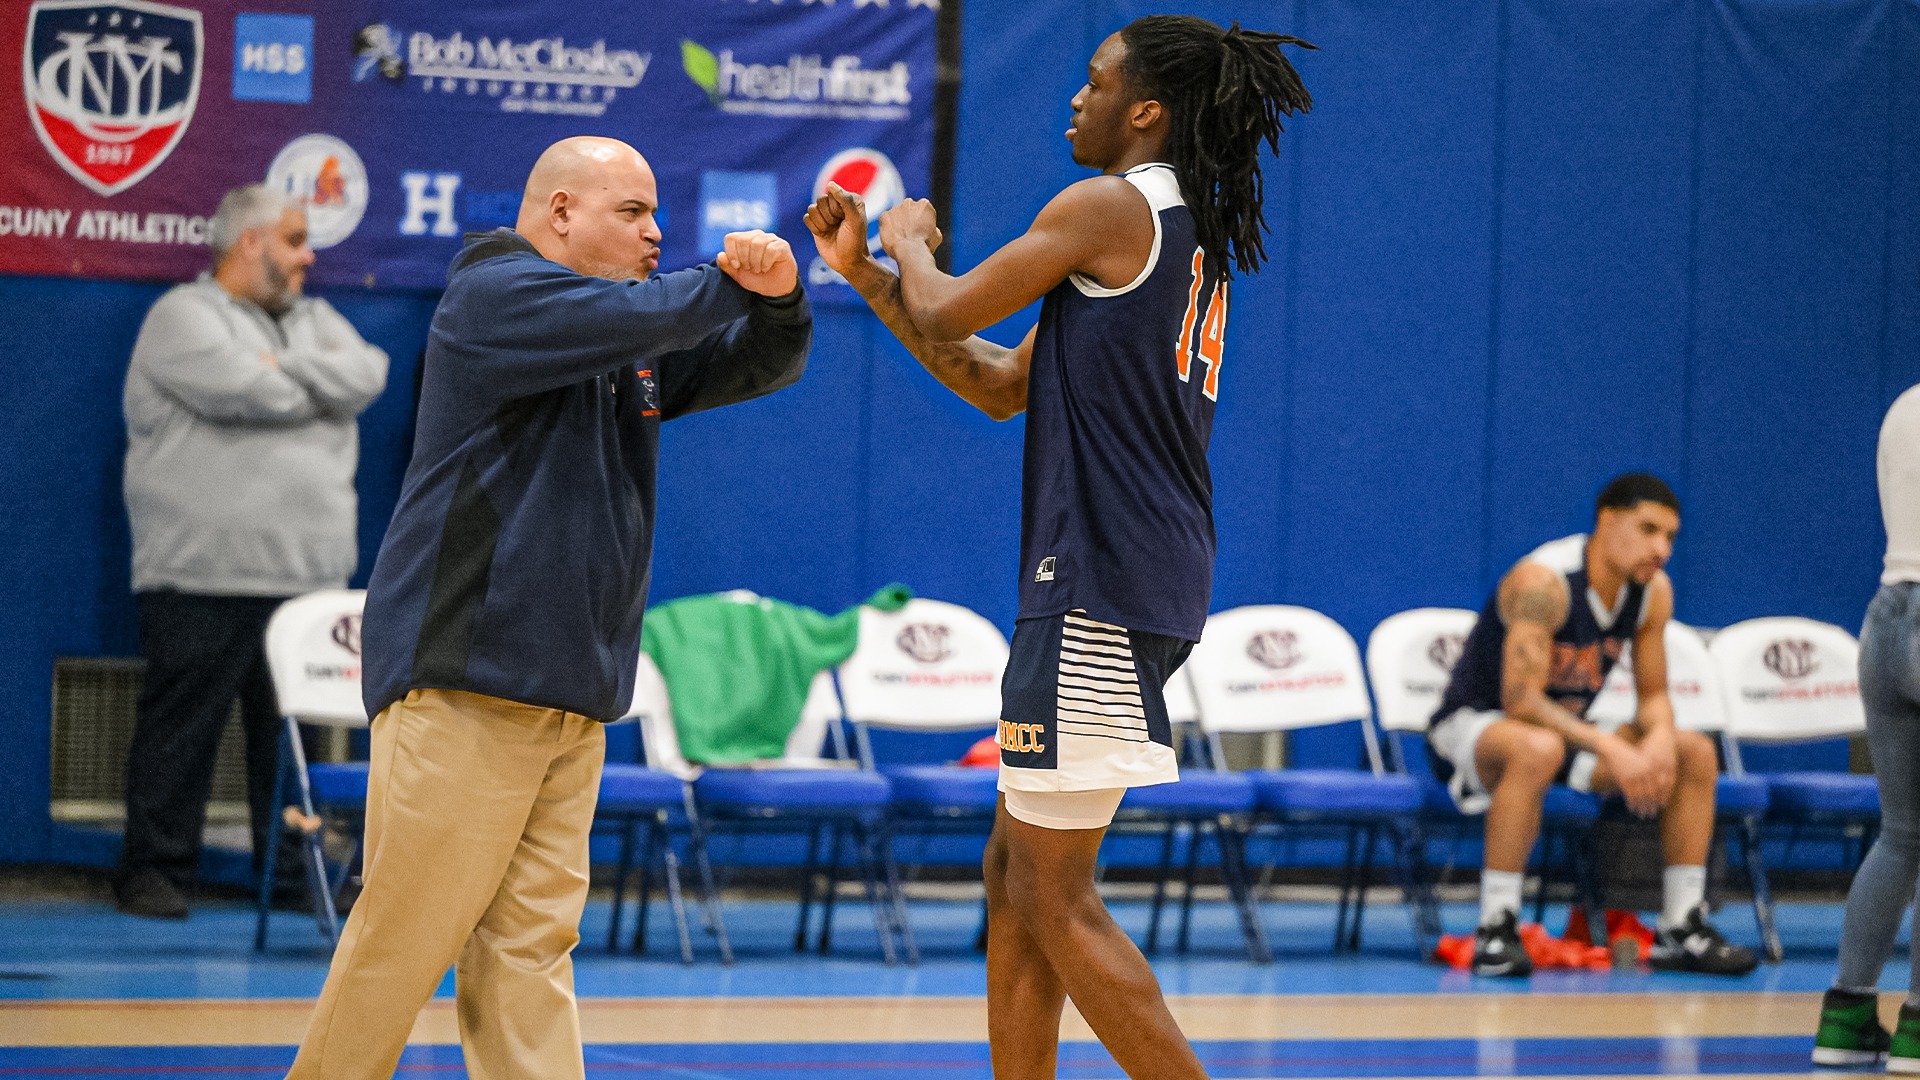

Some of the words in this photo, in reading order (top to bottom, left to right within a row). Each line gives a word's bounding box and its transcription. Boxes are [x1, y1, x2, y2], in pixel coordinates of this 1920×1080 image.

[242, 43, 305, 75] HSS
[408, 31, 474, 68] Bob
[477, 35, 652, 88] McCloskey
[718, 48, 911, 105] healthfirst
[0, 205, 72, 239] CUNY
[400, 171, 462, 237] H
[1176, 246, 1229, 403] 14
[998, 719, 1045, 753] BMCC
